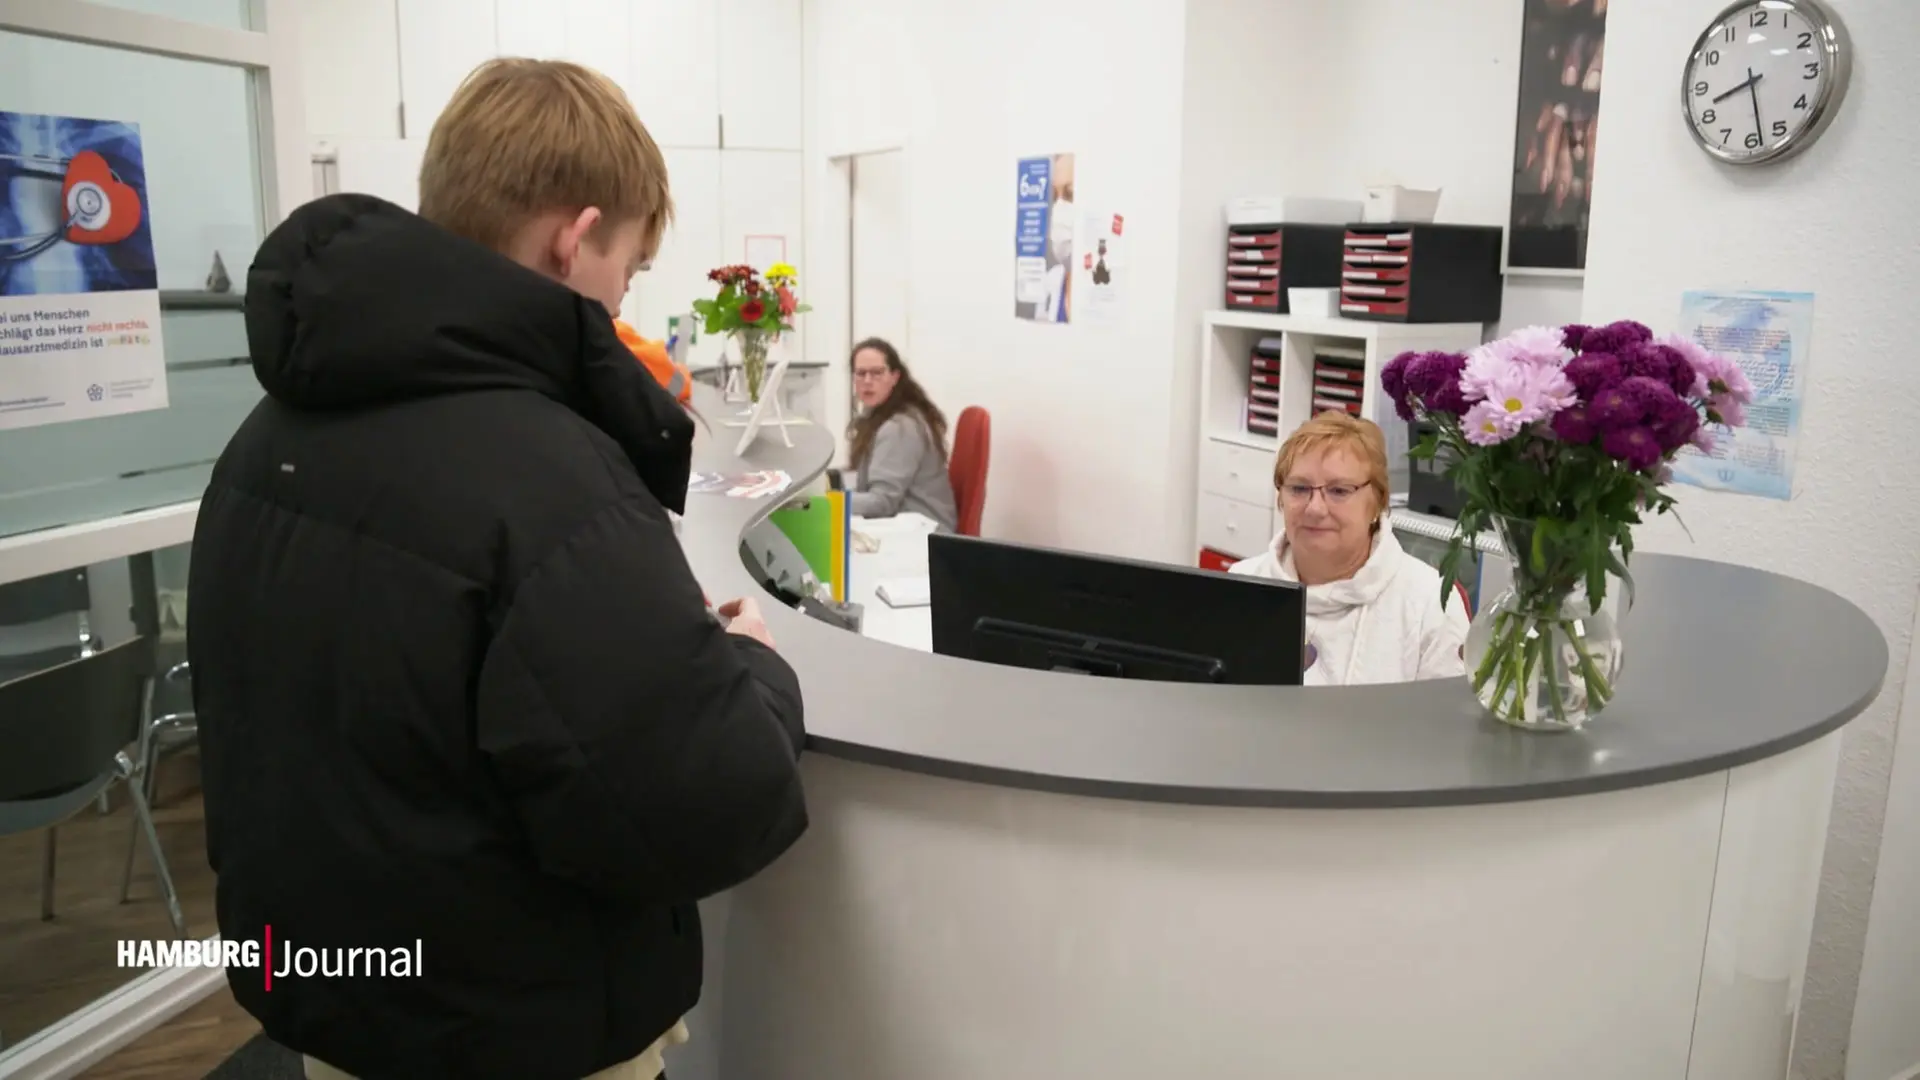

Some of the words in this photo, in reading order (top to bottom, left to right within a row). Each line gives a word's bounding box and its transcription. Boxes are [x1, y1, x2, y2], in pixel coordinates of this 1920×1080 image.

[1749, 11, 1768, 28] 12
[1783, 13, 1788, 28] 1
[1725, 27, 1736, 42] 11
[1797, 32, 1812, 49] 2
[1705, 50, 1720, 66] 10
[1803, 62, 1819, 80] 3
[1695, 81, 1709, 96] 9
[1793, 94, 1808, 110] 4
[1702, 109, 1717, 124] 8
[1720, 128, 1733, 145] 7
[1772, 121, 1787, 137] 5
[1744, 133, 1759, 149] 6
[10, 313, 32, 322] uns
[33, 308, 90, 321] Menschen
[35, 325, 56, 337] das
[58, 323, 84, 334] Herz
[90, 336, 104, 348] ist
